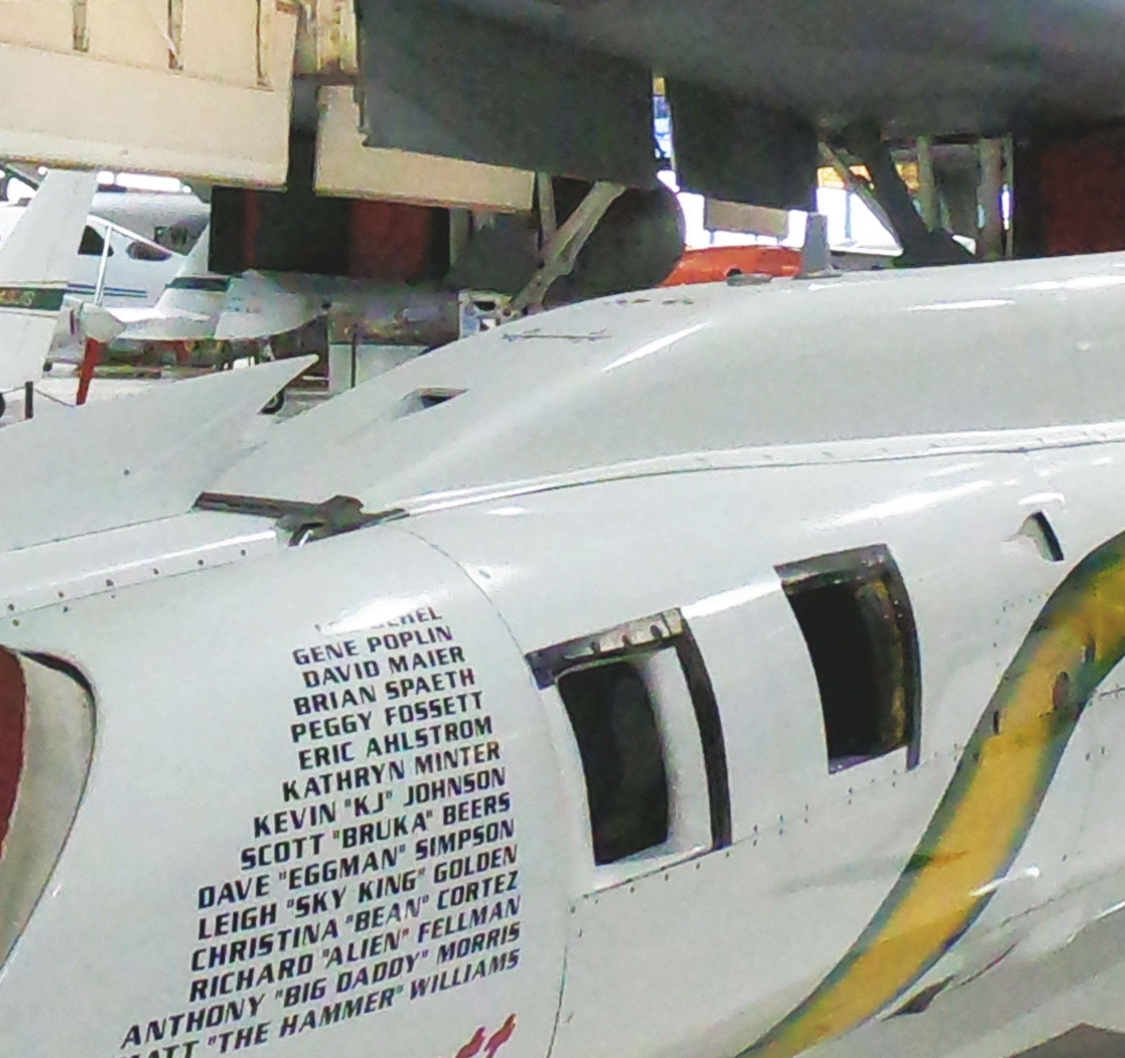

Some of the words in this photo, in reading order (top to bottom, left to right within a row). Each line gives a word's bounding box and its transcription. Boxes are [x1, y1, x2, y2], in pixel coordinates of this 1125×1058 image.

[293, 639, 358, 666] GENE
[367, 626, 453, 653] POPLIN
[303, 659, 380, 689] DAVID
[389, 646, 464, 673] MAIER
[291, 711, 372, 742] PEGGY
[385, 691, 482, 726] FOSSETT
[294, 685, 375, 716] BRIAN
[385, 668, 474, 700] SPAETH
[283, 760, 404, 801] KATHRYN
[415, 740, 500, 774] MINTER
[299, 742, 354, 770] ERIC
[366, 715, 492, 759] AHLSTROM
[241, 833, 324, 870] SCOTT
[333, 811, 433, 851] "BRUKA"
[442, 792, 511, 826] BEERS
[254, 802, 335, 838] KEVIN
[345, 790, 393, 816] "KJ"
[403, 767, 505, 807] JOHNSON
[197, 875, 270, 910] DAVE
[279, 844, 405, 890] "EGGMAN"
[415, 818, 514, 860] SIMPSON
[198, 903, 275, 940] LEIGH
[287, 886, 346, 918] "SKY
[358, 868, 425, 903] KING"
[433, 844, 517, 884] GOLDEN
[189, 954, 313, 1002] RICHARD
[322, 929, 409, 969] "ALIEN"
[417, 895, 520, 943] FELLMAN
[191, 920, 338, 972] CHRISTINA
[345, 894, 429, 932] "BEAN"
[436, 870, 518, 911] CORTEZ
[120, 994, 265, 1049] ANTHONY
[276, 977, 325, 1009] "BIG
[336, 950, 428, 994] DADDY"
[436, 922, 520, 964] MORRIS
[207, 1019, 270, 1054] "THE
[279, 985, 403, 1038] HAMMER"
[410, 949, 520, 1000] WILLIAMS
